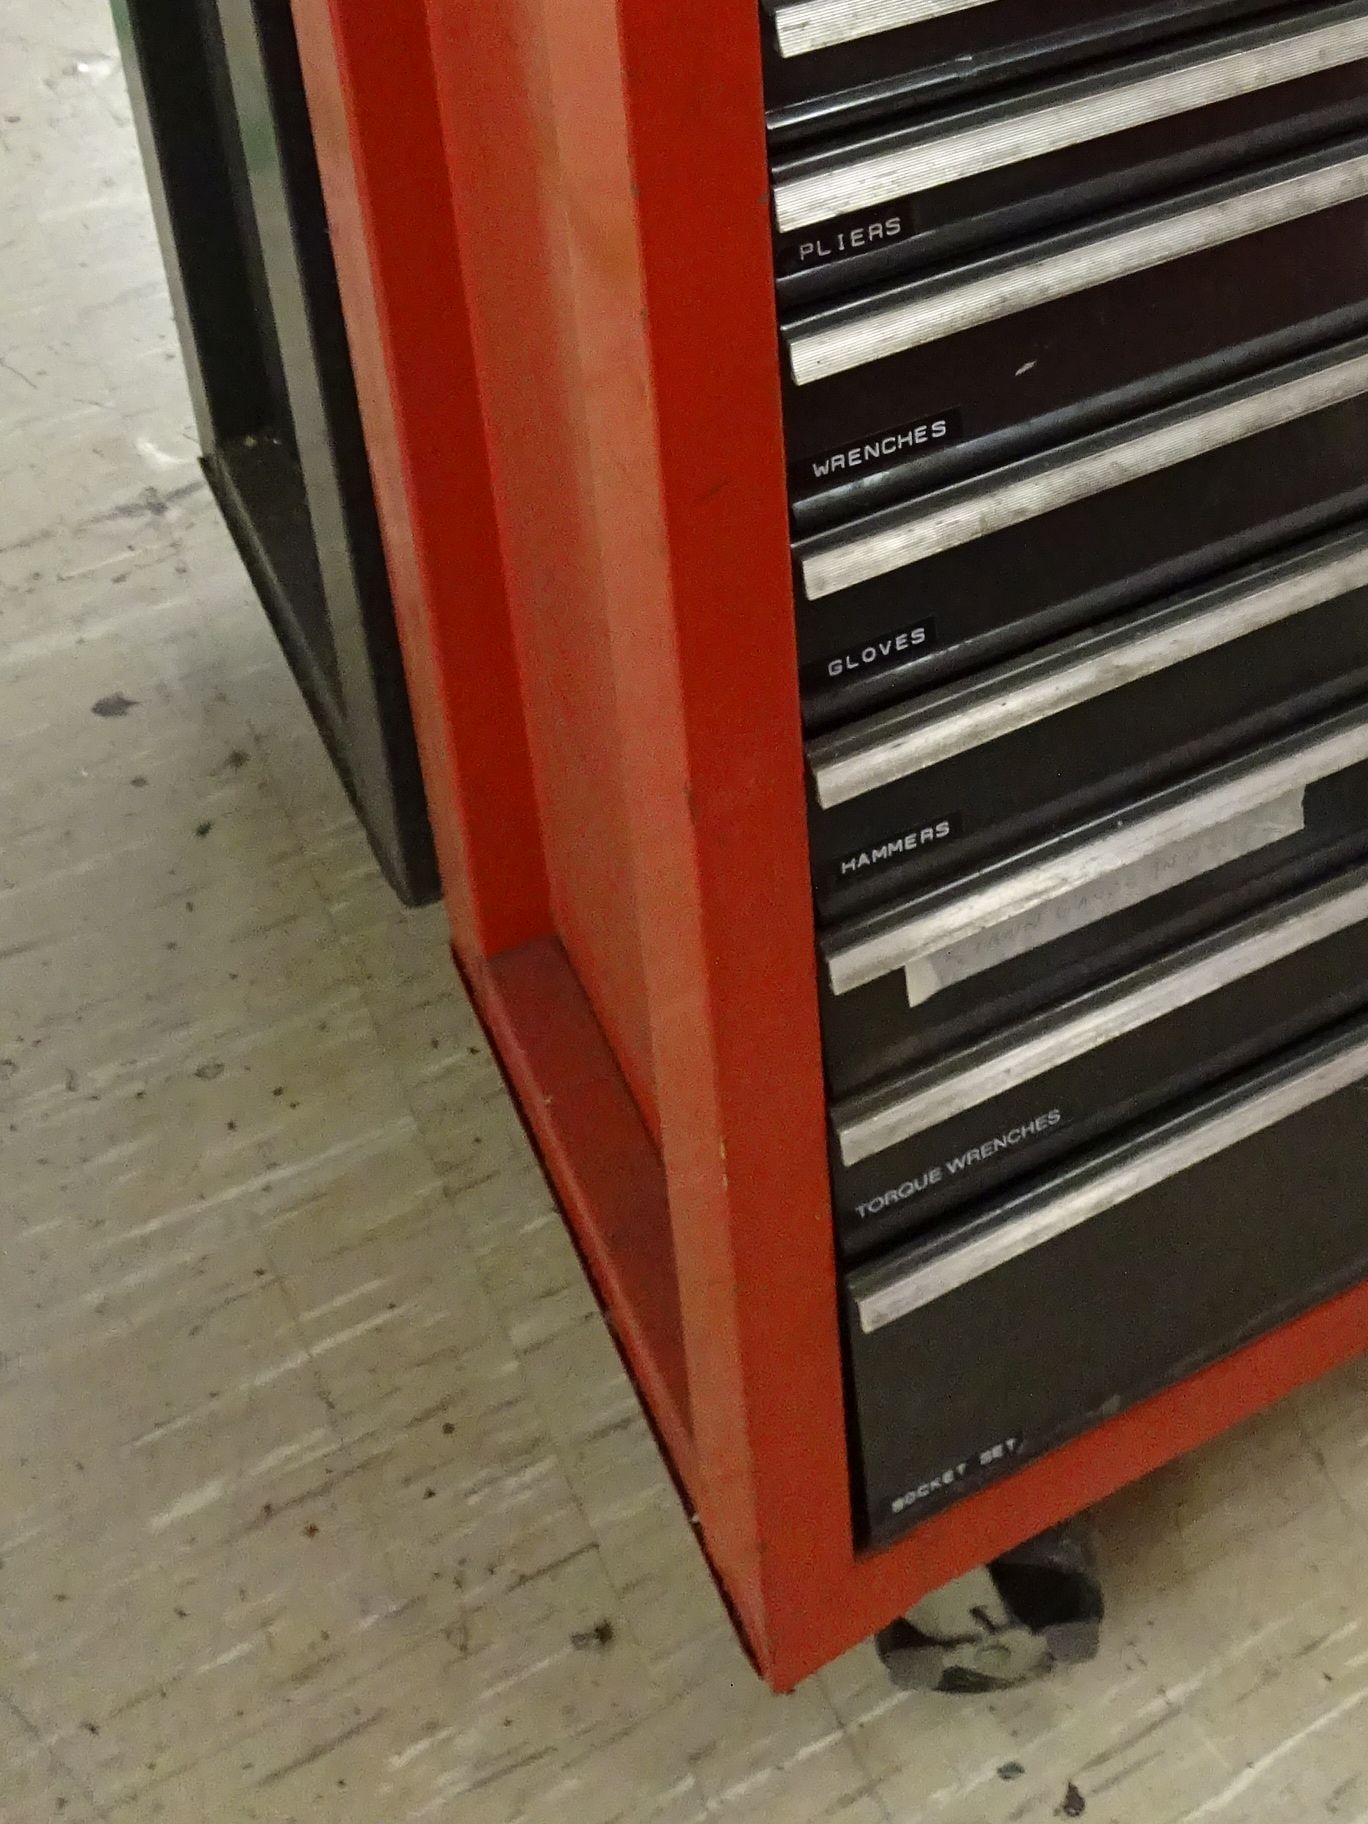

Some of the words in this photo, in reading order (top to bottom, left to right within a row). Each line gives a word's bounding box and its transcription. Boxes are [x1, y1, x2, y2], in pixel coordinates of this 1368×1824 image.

[800, 217, 901, 260] PLIERS
[812, 420, 947, 478] WRENCHES
[828, 627, 926, 676] GLOVES
[841, 822, 949, 874] HAMMERS
[855, 1167, 943, 1218] TORQUE
[946, 1109, 1061, 1174] WRENCHES
[892, 1463, 967, 1513] SOCKET
[980, 1438, 1017, 1465] SET
